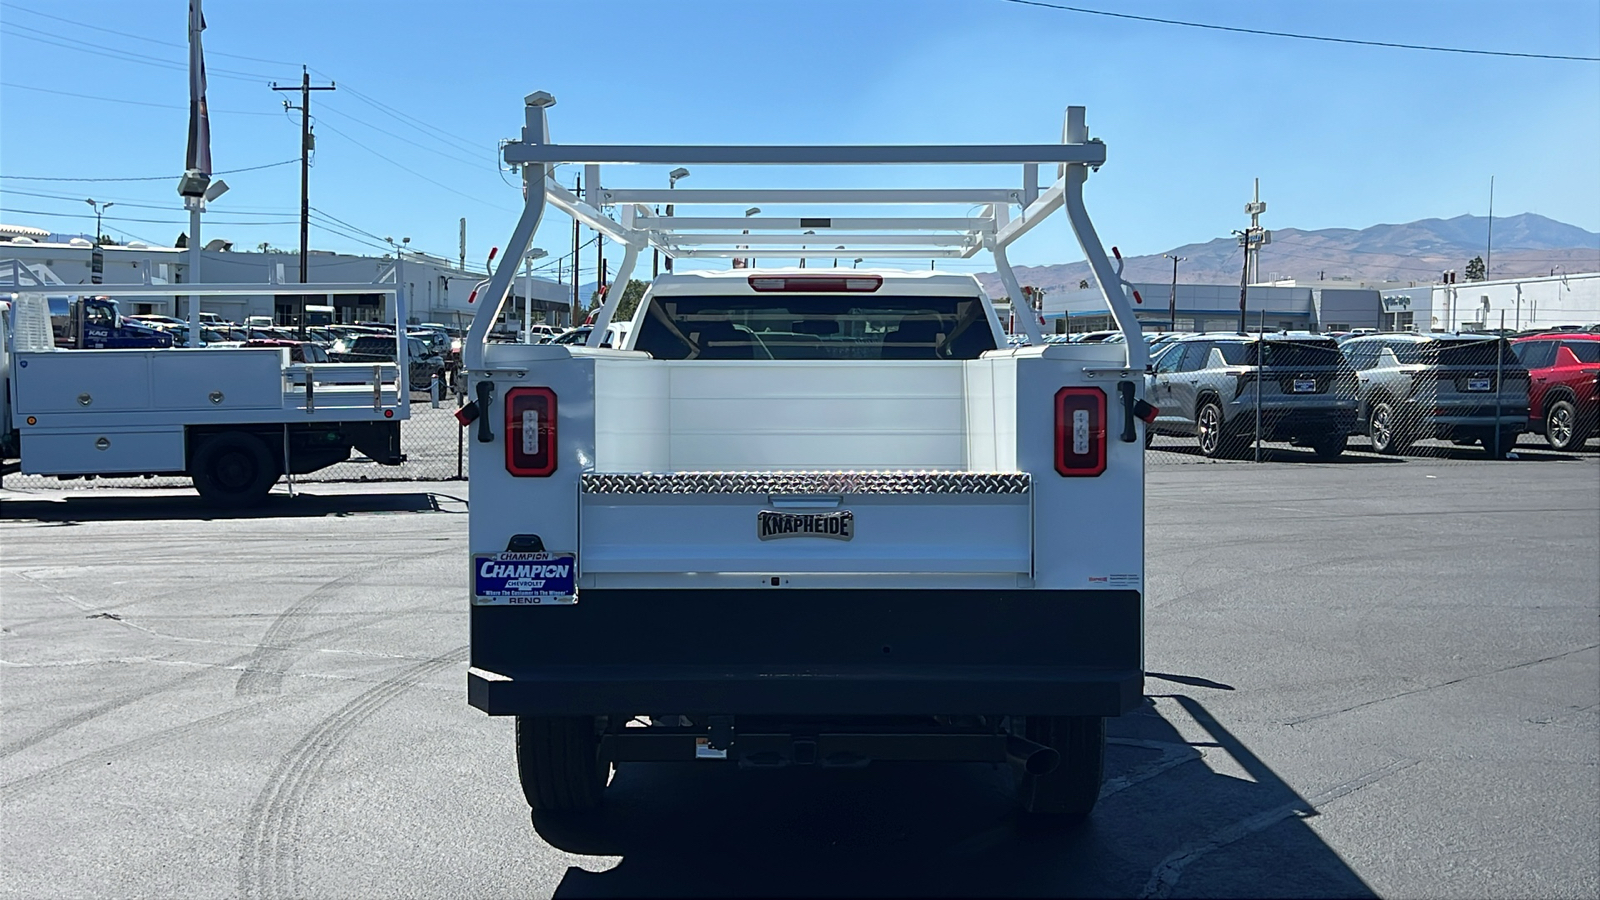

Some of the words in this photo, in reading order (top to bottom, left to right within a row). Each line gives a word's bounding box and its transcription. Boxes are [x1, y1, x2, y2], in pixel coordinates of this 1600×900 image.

[762, 514, 849, 536] KNAPHEIDE
[500, 553, 549, 561] CHAMPION
[480, 561, 570, 578] CHAMPION
